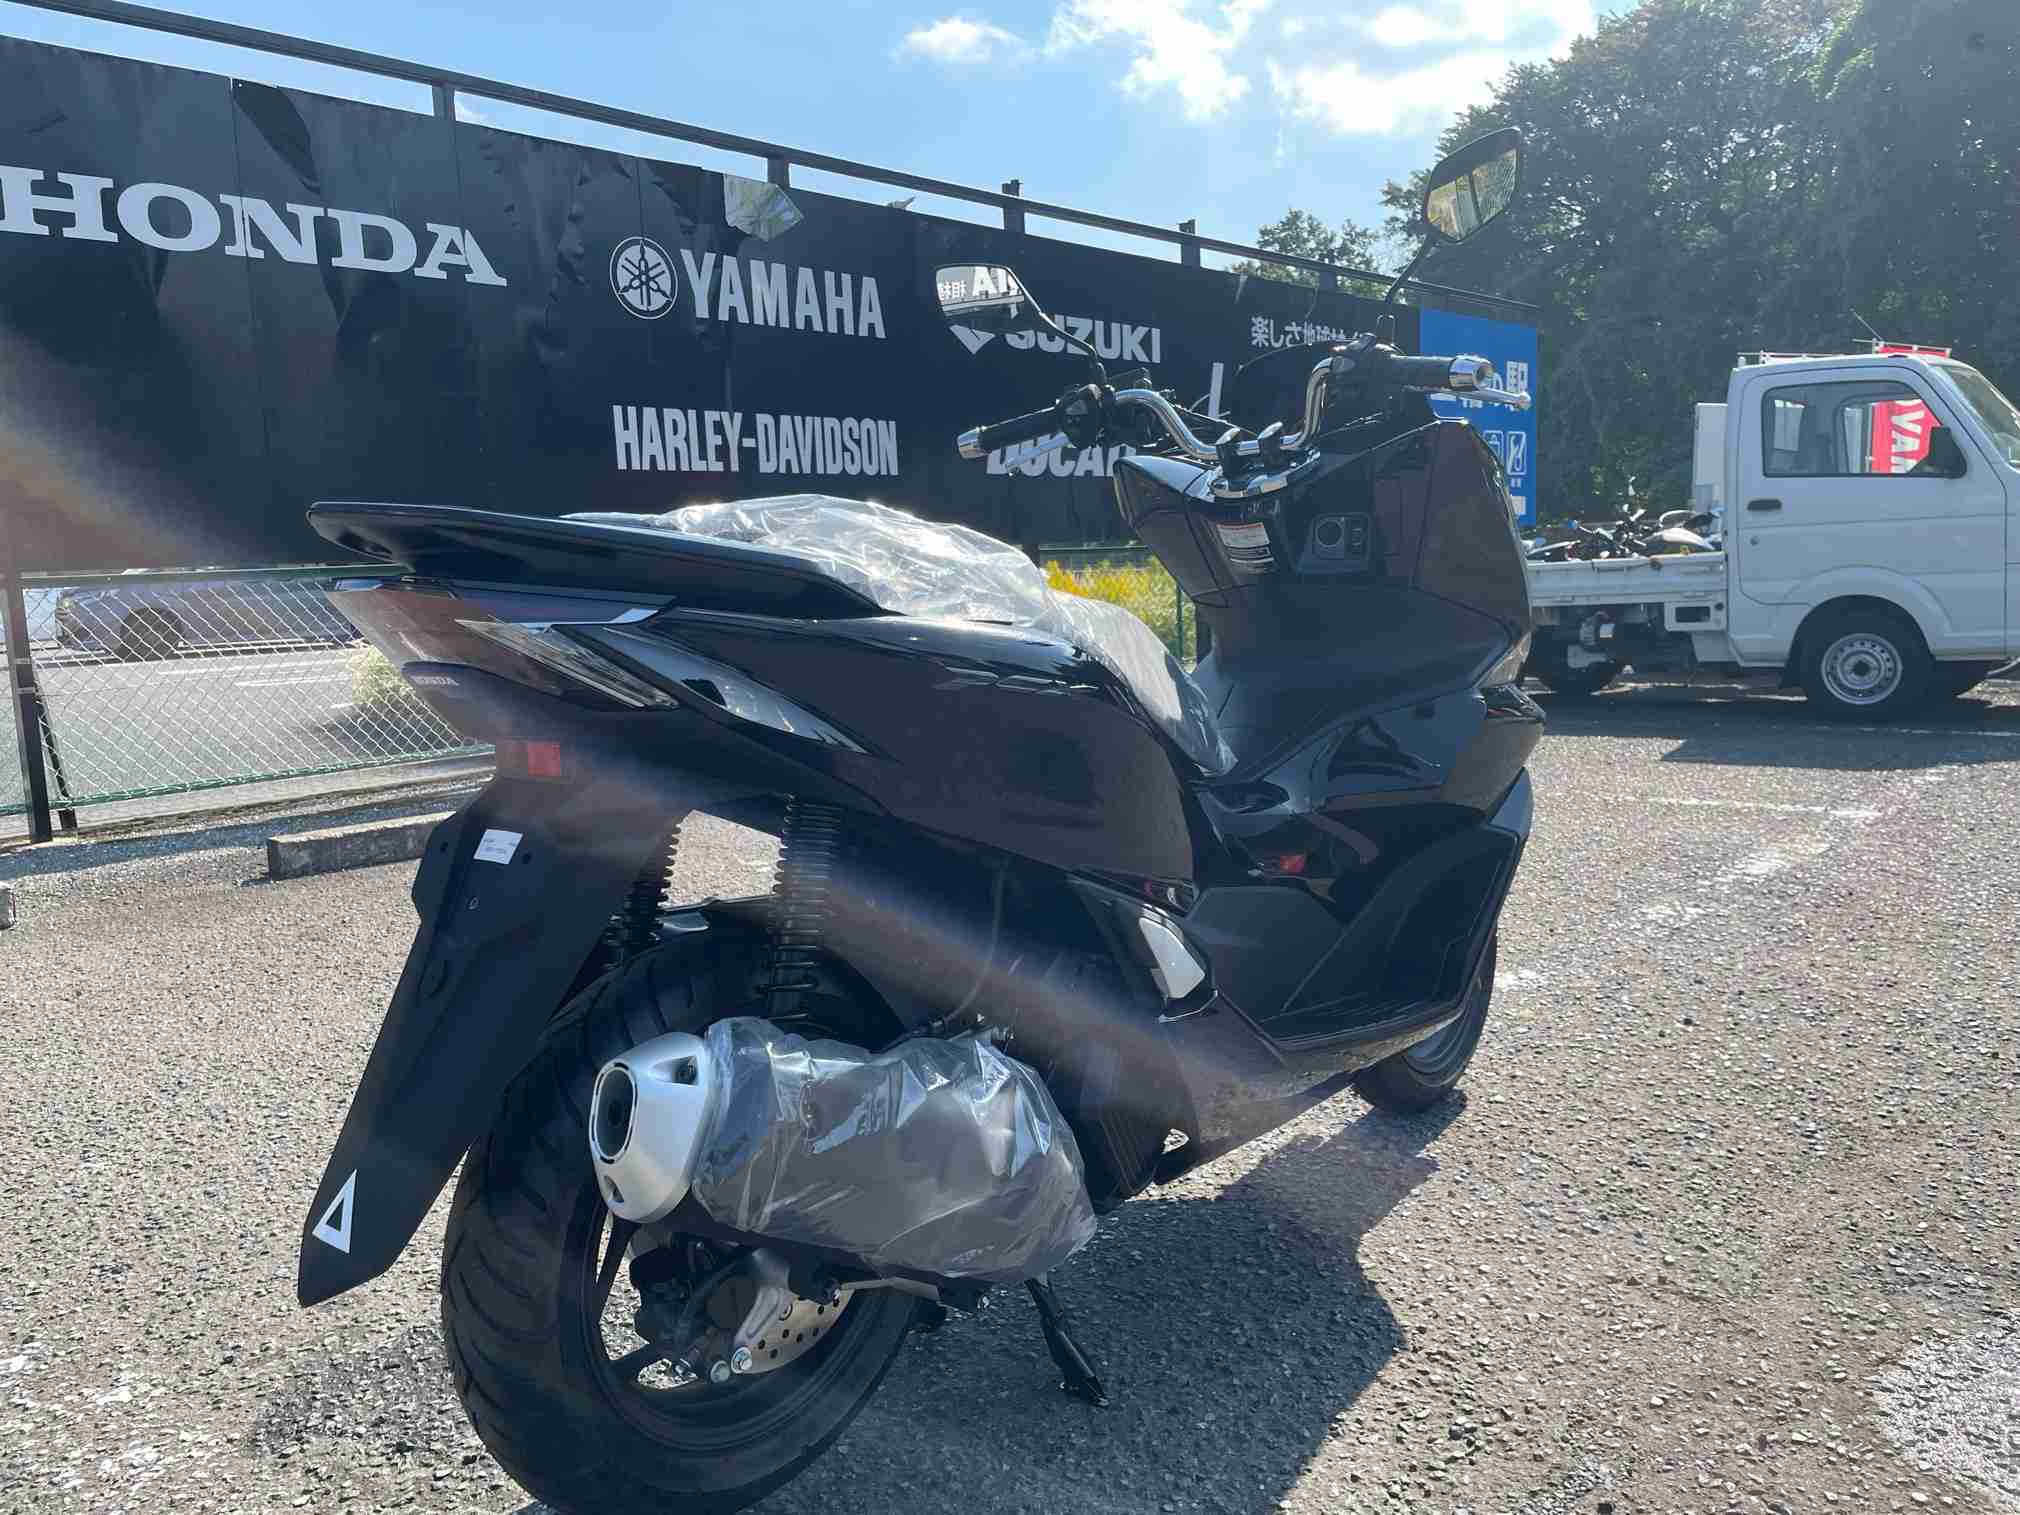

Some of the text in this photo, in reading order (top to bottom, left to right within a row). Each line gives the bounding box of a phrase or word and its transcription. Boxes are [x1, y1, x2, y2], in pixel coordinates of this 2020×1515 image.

[0, 165, 507, 287] HONDA
[680, 249, 887, 339] YAMAHA
[612, 404, 899, 476] HARLEY-DAVIDSON
